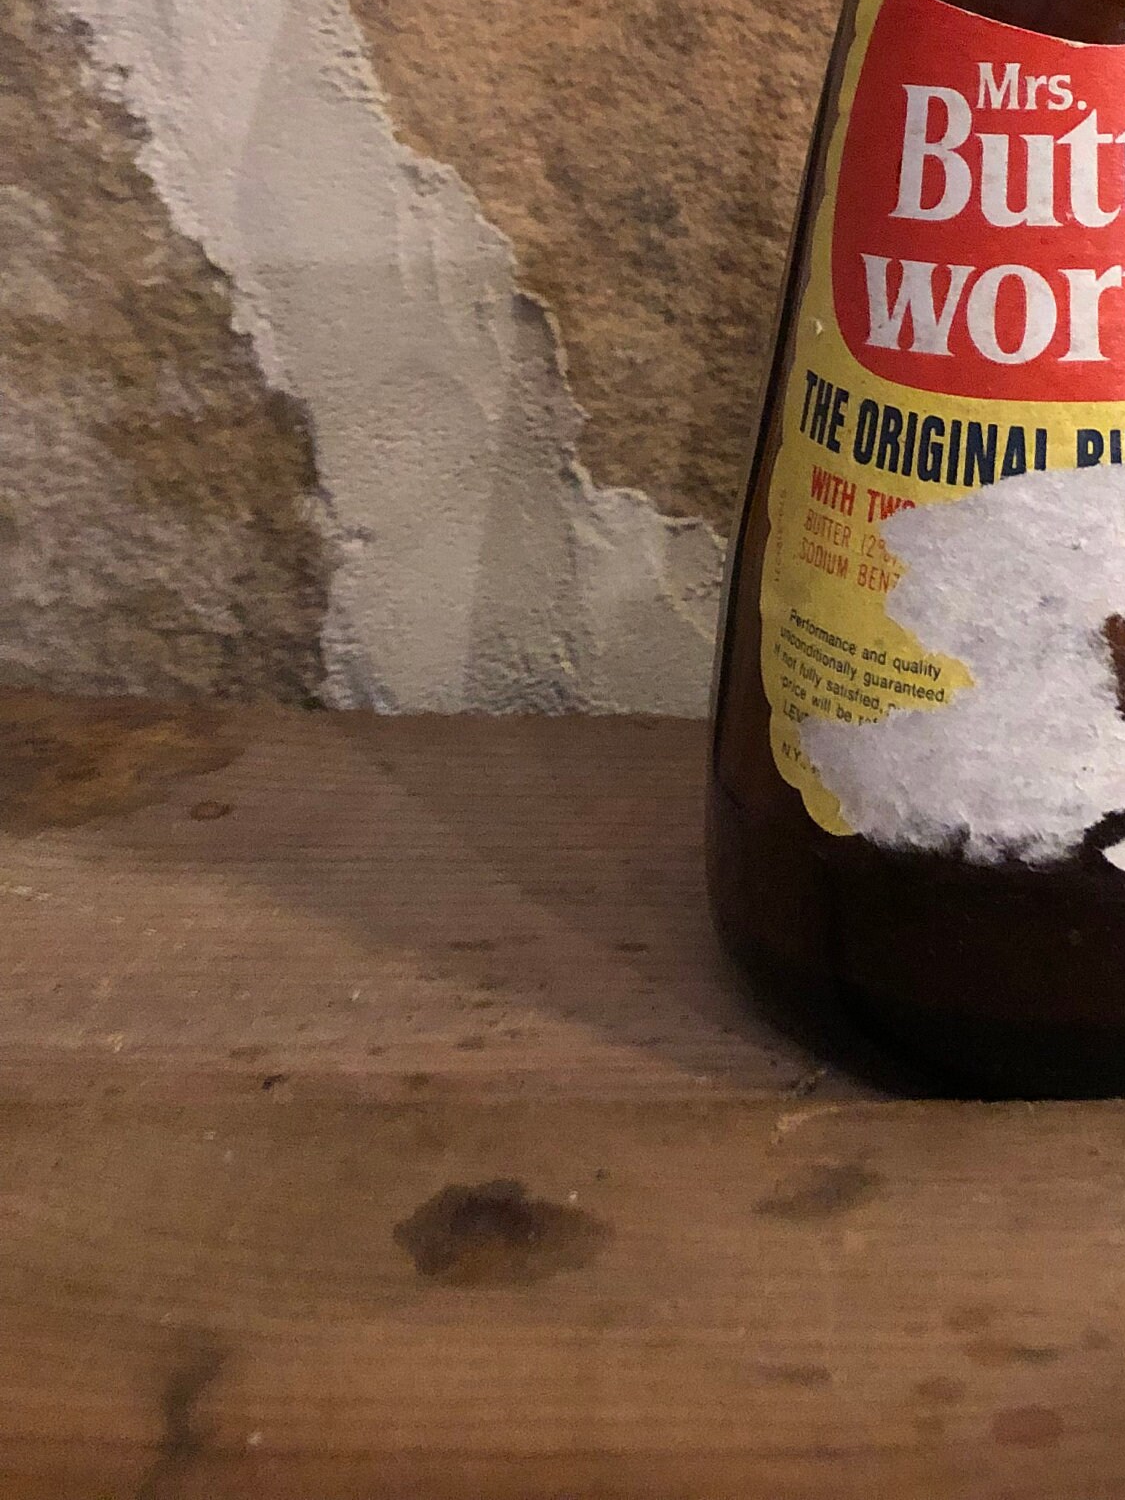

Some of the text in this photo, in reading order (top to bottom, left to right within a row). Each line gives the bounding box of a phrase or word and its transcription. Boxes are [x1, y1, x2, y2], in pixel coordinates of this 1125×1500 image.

[976, 62, 1087, 111] Mrs.
[800, 369, 849, 453] THE
[811, 464, 857, 516] WITH
[804, 509, 851, 549] BUTTER
[800, 536, 849, 579] SODIUM
[780, 626, 857, 681] unconditionally
[790, 609, 941, 681] Performance and quality
[836, 702, 853, 723] be
